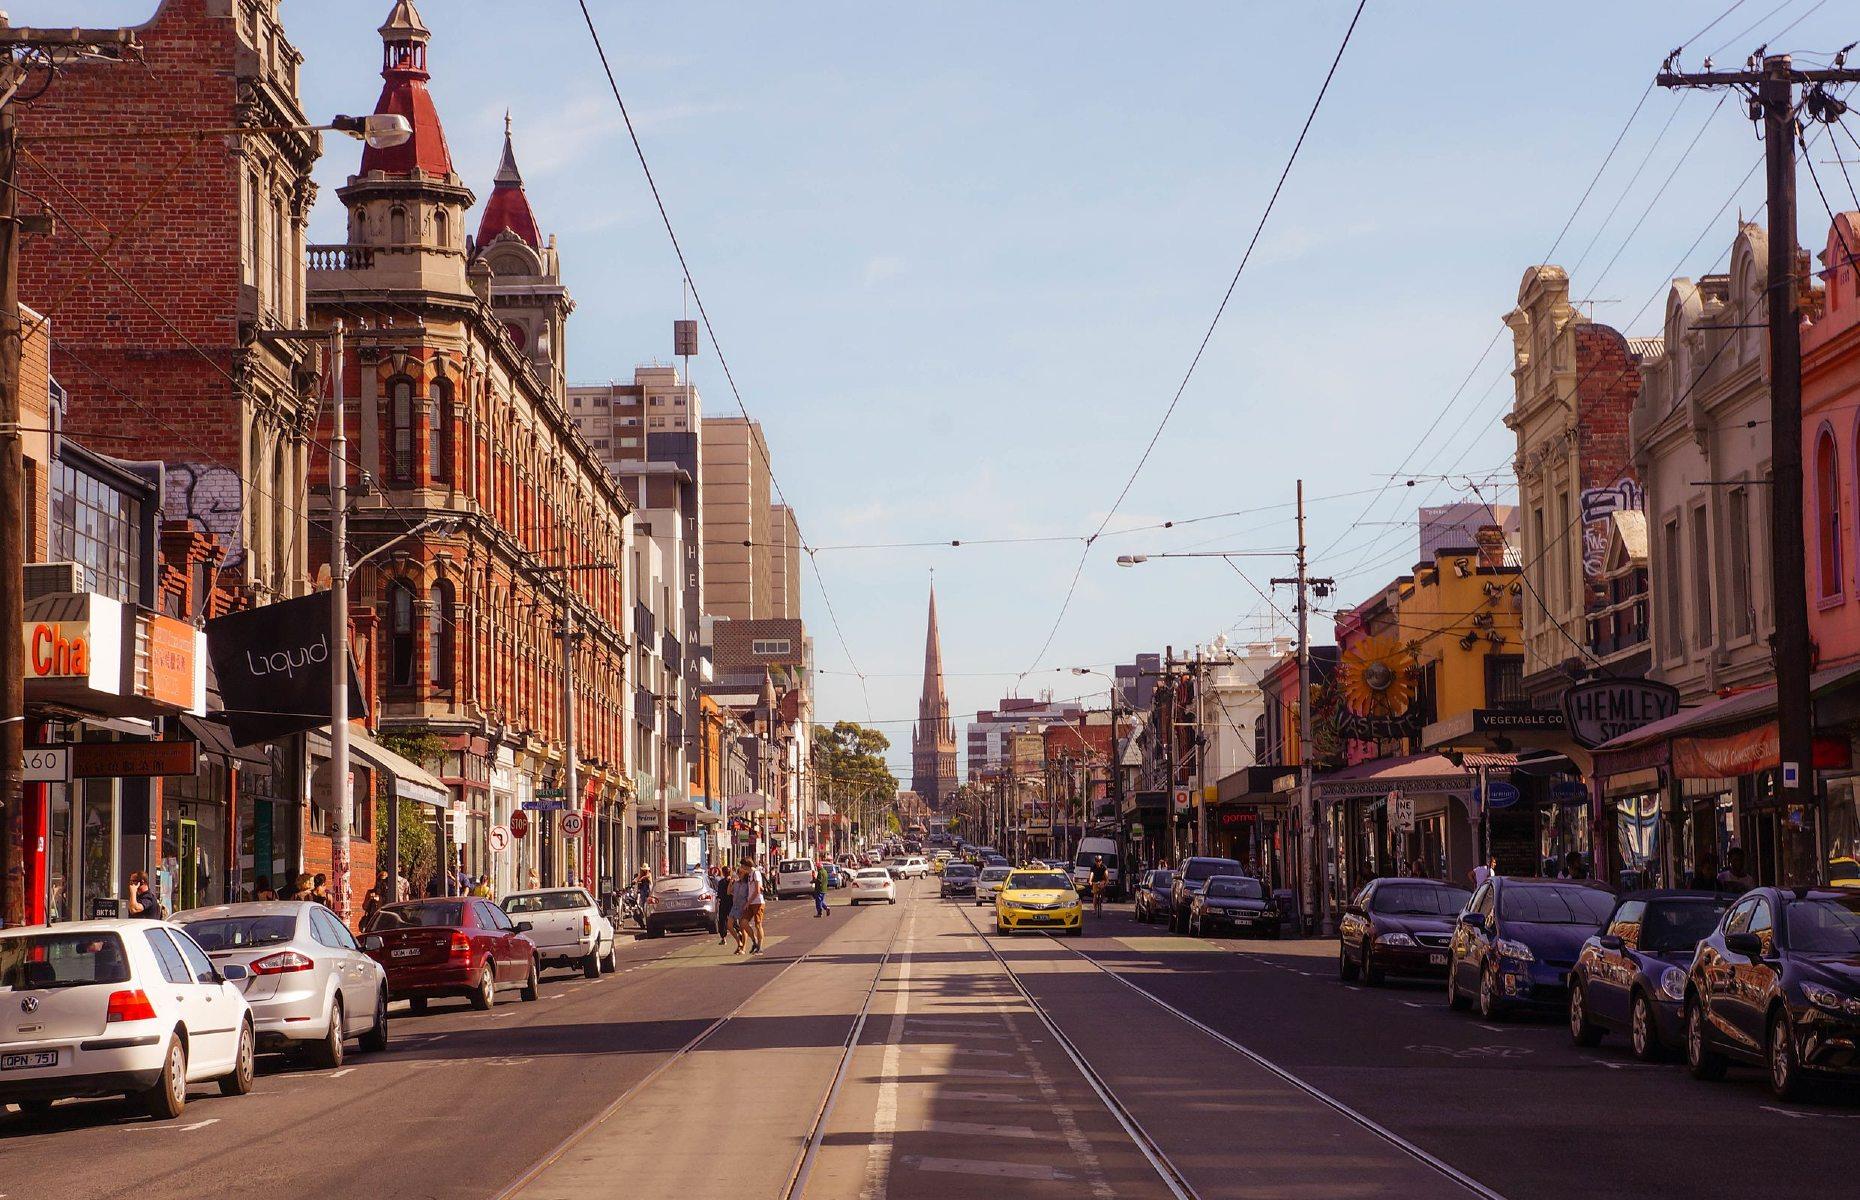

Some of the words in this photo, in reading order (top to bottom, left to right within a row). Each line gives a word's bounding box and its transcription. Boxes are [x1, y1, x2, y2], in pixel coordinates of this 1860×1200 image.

[688, 517, 696, 588] THE
[246, 633, 328, 679] Liquid
[688, 630, 698, 701] MAX
[1482, 714, 1546, 726] VEGETABLE
[1576, 687, 1668, 721] HEMLEY
[510, 818, 527, 830] STOP
[565, 818, 580, 829] 40
